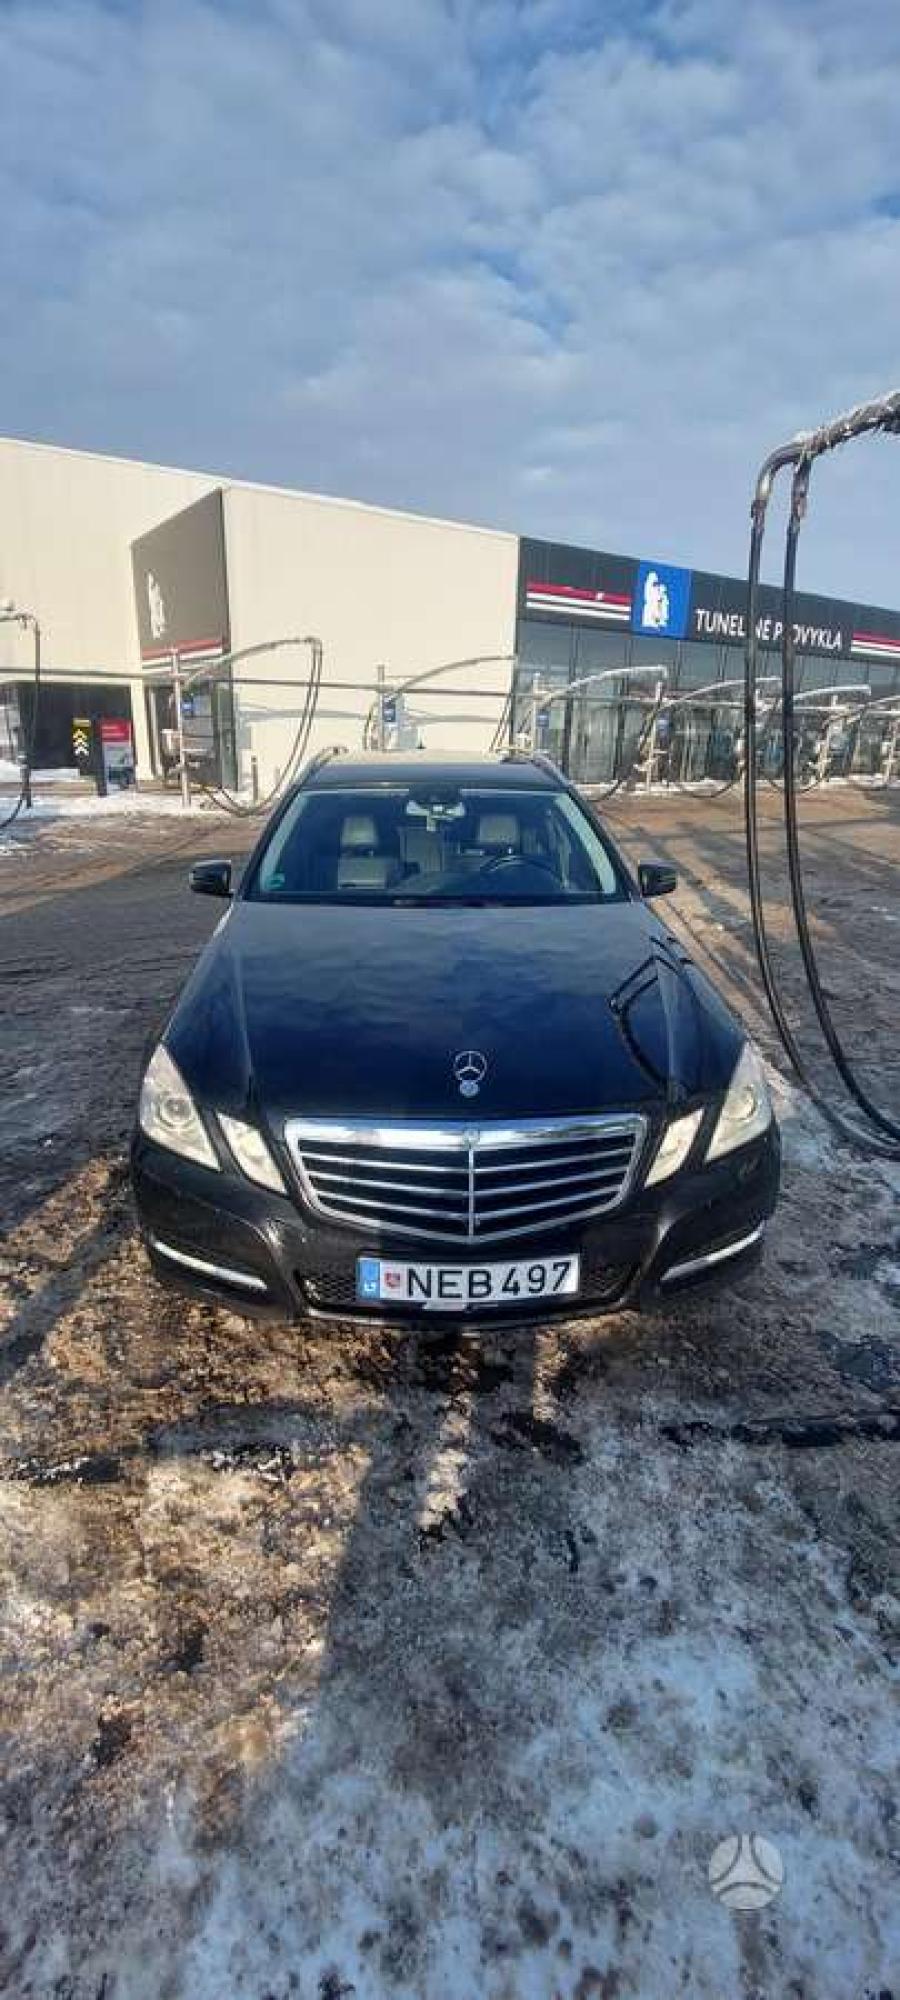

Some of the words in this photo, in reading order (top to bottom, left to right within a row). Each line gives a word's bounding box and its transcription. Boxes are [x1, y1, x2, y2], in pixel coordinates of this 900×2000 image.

[772, 620, 842, 652] POVYKLA
[407, 1268, 492, 1299] NEB
[501, 1261, 572, 1296] 497
